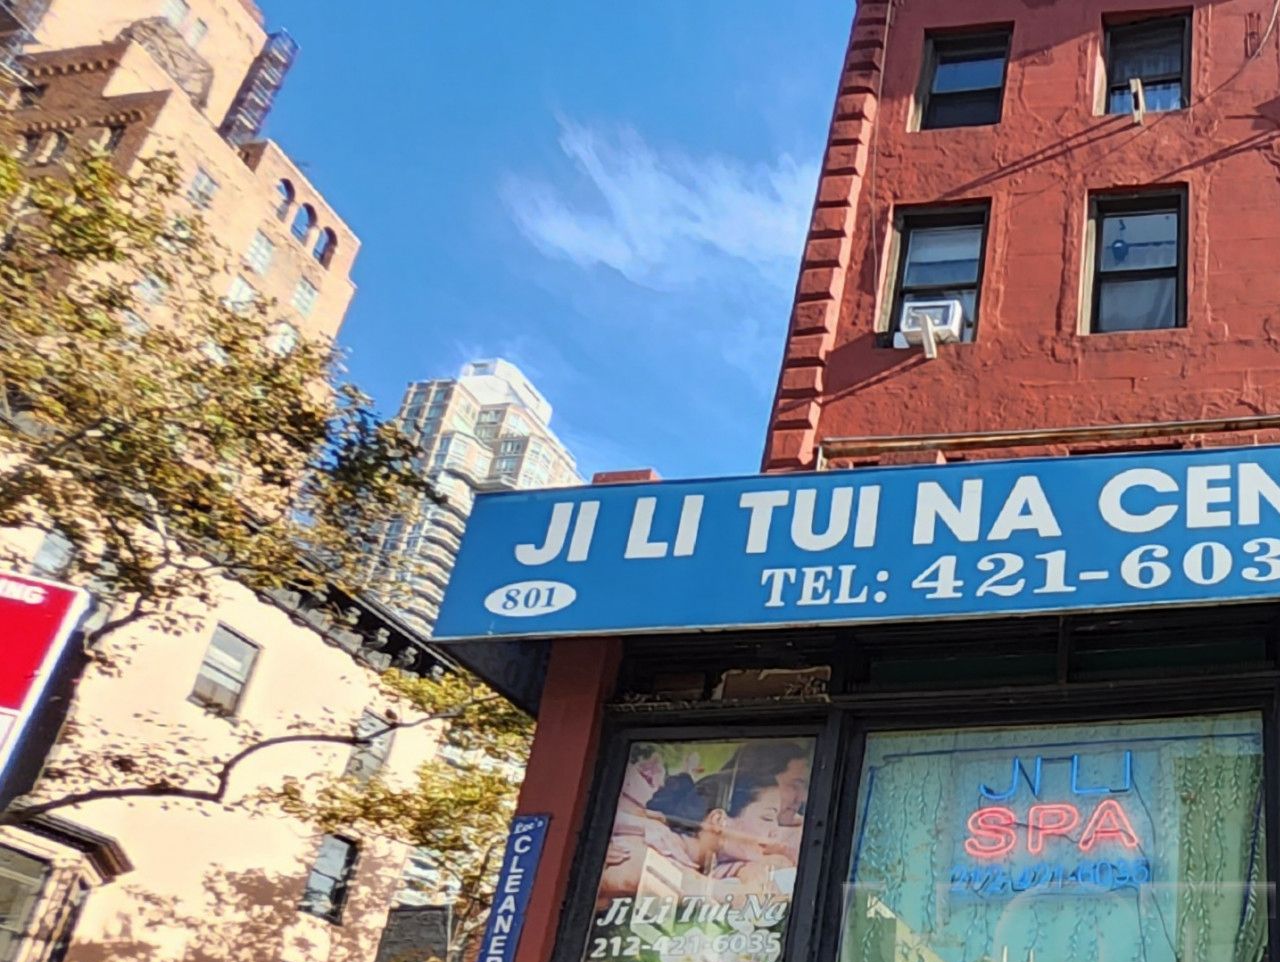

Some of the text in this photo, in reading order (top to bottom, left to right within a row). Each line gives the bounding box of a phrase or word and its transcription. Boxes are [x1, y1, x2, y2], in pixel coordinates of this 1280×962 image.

[514, 500, 600, 566] JI
[624, 495, 704, 559] LI
[738, 485, 882, 554] TUI
[912, 475, 1062, 545] NA
[501, 586, 557, 611] 801
[761, 563, 890, 607] TEL:
[963, 800, 1139, 859] SPA
[597, 896, 632, 927] Ji
[634, 895, 674, 925] Li
[589, 931, 782, 959] 212-421-6035
